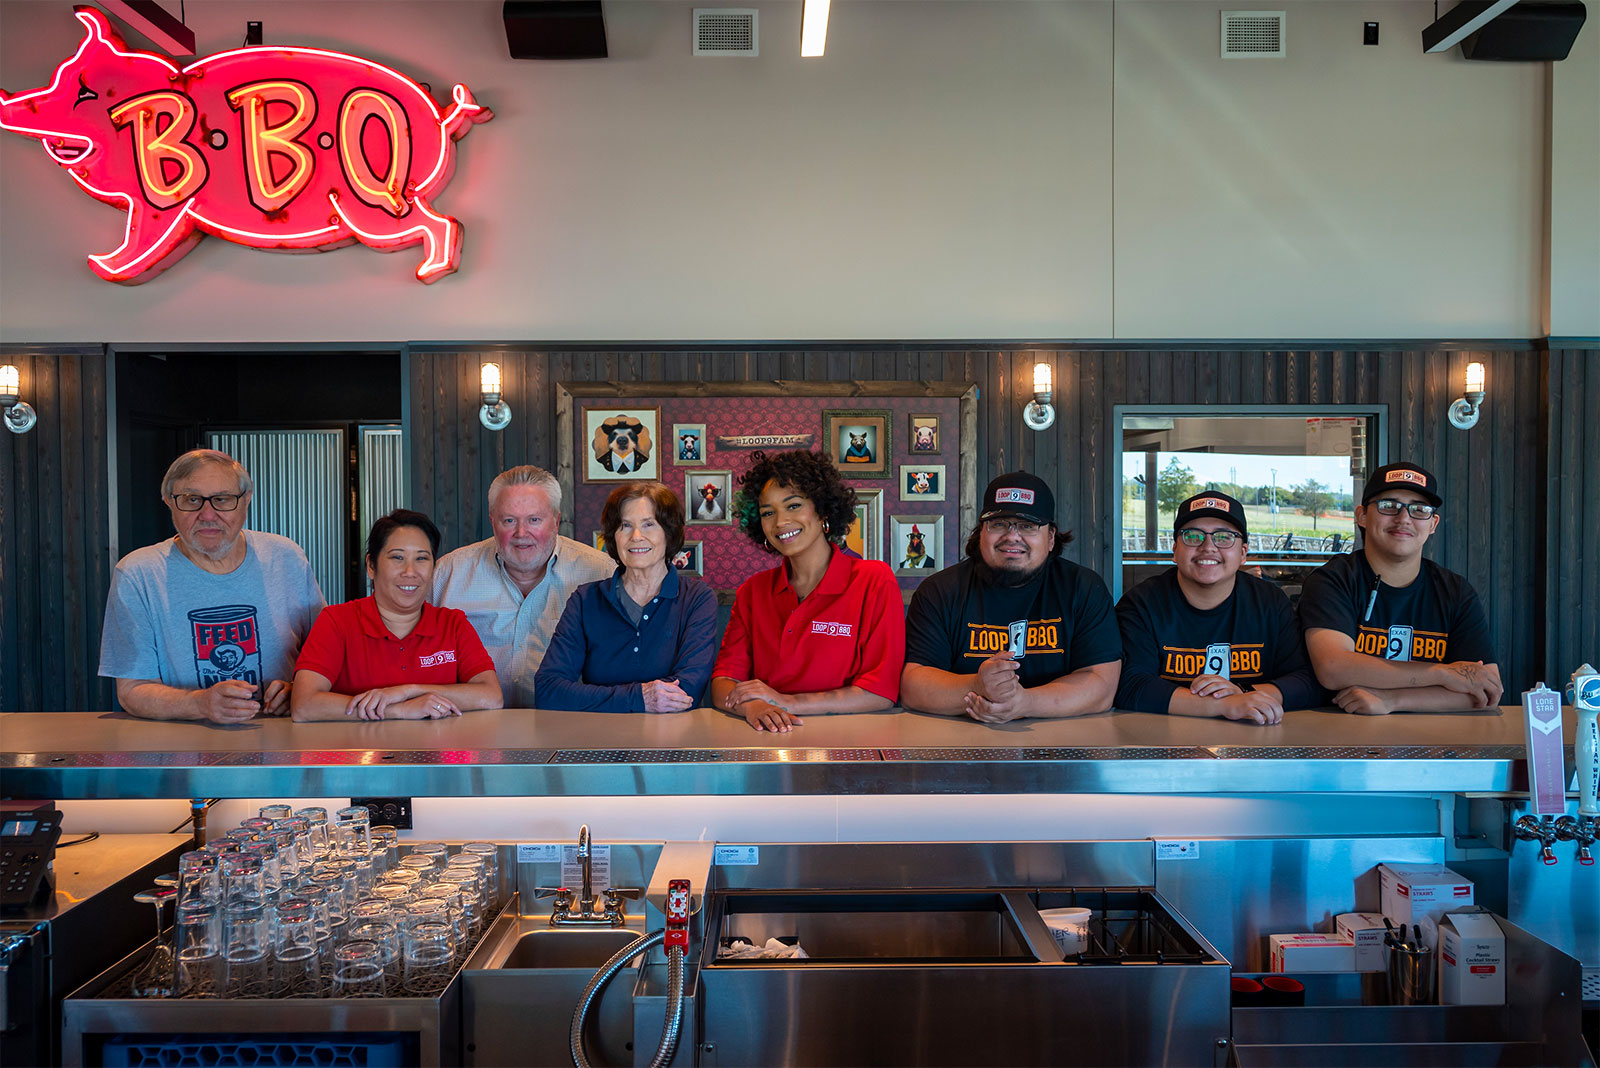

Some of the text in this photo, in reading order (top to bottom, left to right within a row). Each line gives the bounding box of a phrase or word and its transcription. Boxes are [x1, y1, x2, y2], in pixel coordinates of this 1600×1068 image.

[736, 437, 794, 445] #LOOP9FAM
[998, 491, 1010, 499] LOOP
[1020, 492, 1031, 501] BBQ
[198, 621, 253, 646] FEED
[812, 623, 851, 635] LOOP 9 BBQ
[969, 630, 1009, 651] LOOP
[1026, 625, 1058, 648] BBQ
[1389, 637, 1403, 659] 9
[1412, 636, 1447, 661] BBQ
[420, 657, 435, 665] LOOP
[437, 655, 444, 664] 9
[1165, 650, 1261, 675] LOOP 9 BBQ
